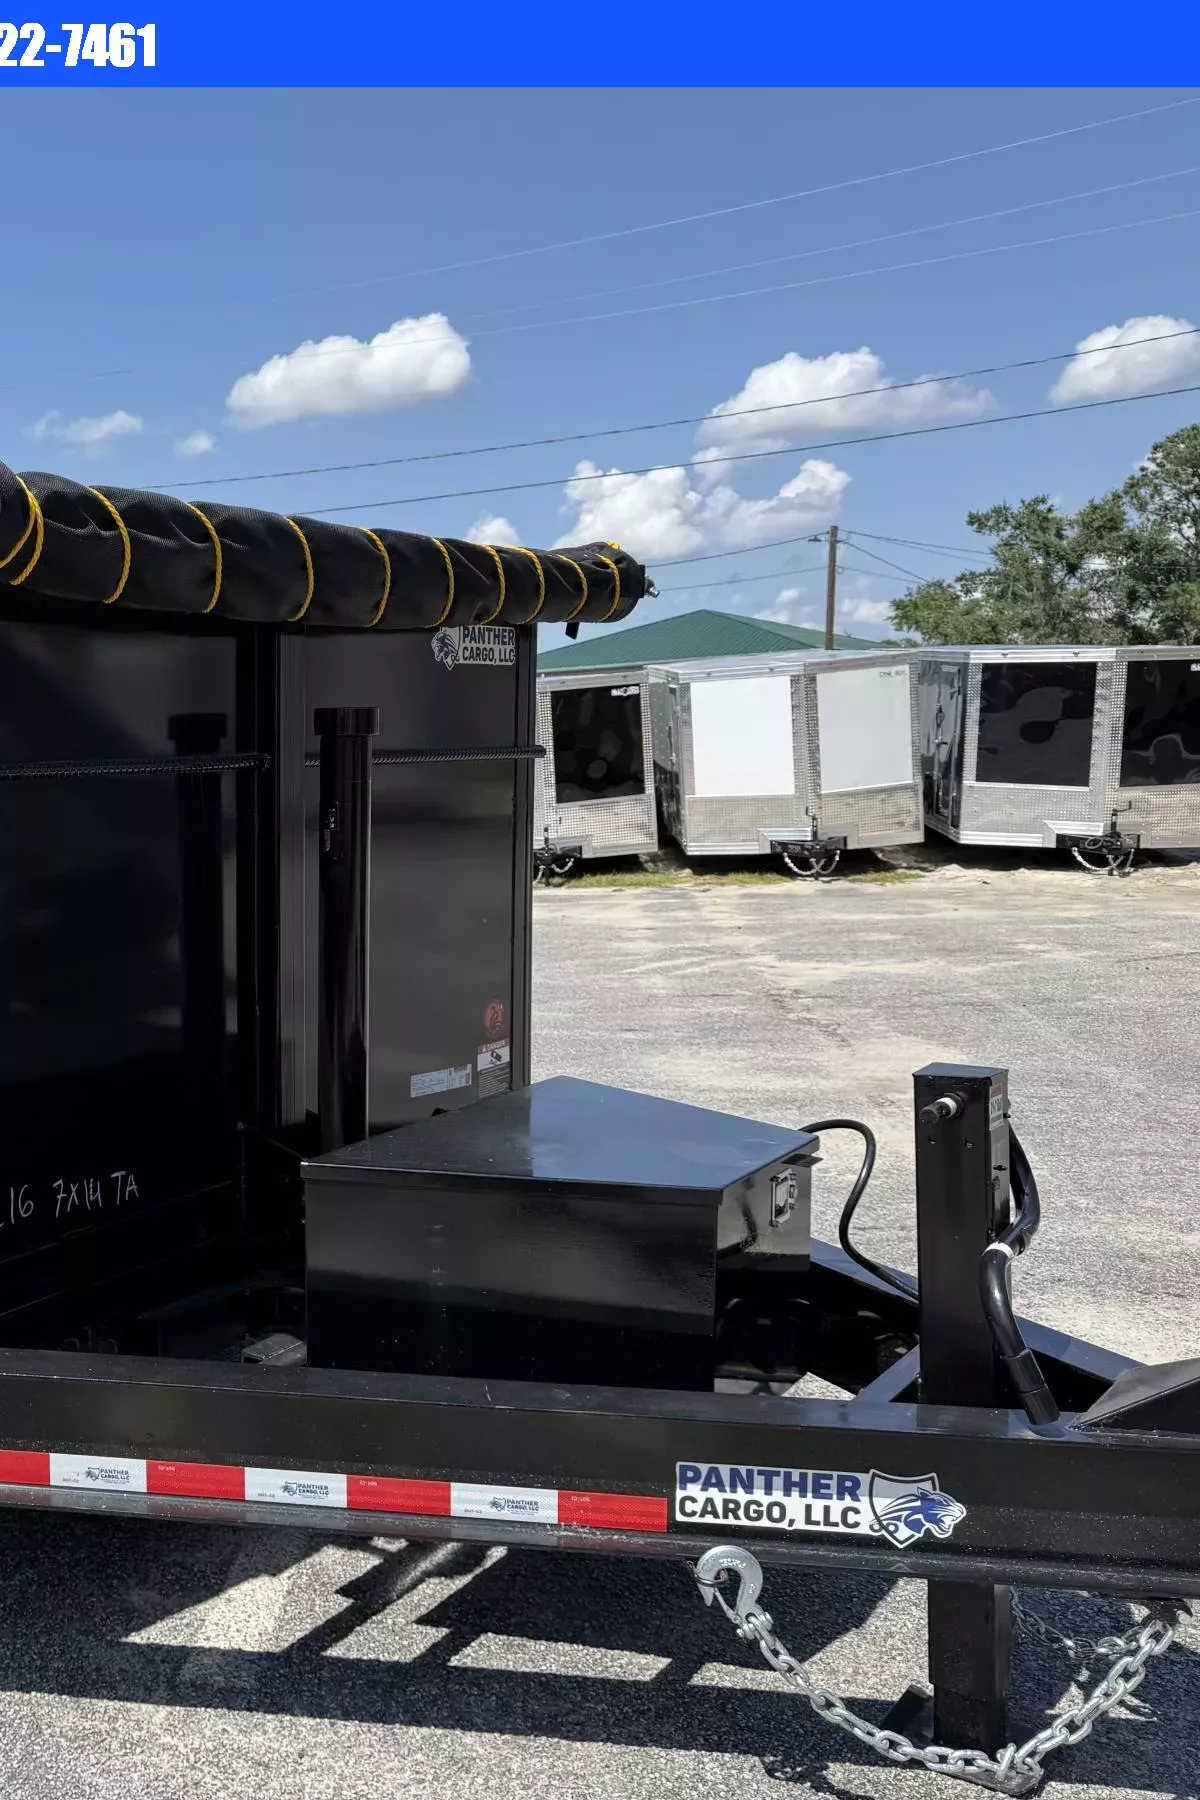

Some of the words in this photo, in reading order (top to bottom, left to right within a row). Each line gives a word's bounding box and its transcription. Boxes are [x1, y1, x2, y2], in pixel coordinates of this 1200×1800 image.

[462, 626, 515, 646] PANTHER
[462, 646, 498, 664] CARGO,
[498, 648, 516, 663] LLC
[110, 1170, 139, 1205] TA
[100, 1468, 130, 1476] PANTHER
[297, 1483, 329, 1491] PANTHER
[678, 1464, 862, 1502] PANTHER
[506, 1498, 539, 1506] PANTHER
[678, 1495, 796, 1529] CARGO,
[804, 1503, 862, 1529] LLC
